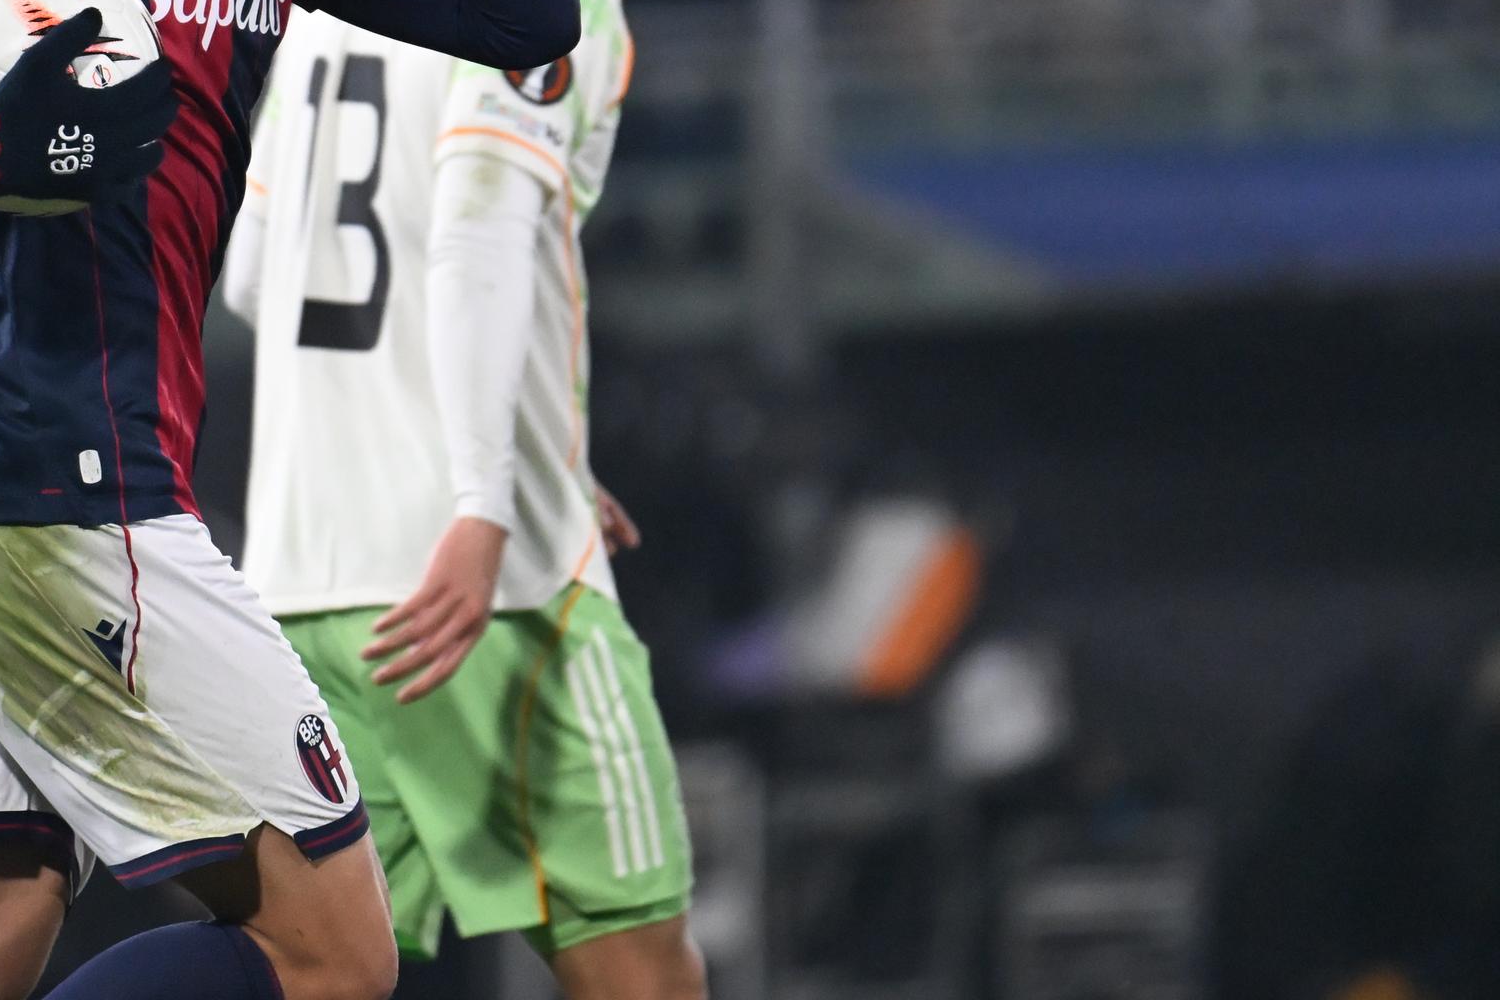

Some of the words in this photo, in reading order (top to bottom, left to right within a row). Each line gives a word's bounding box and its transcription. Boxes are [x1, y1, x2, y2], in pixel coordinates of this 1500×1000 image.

[48, 124, 81, 174] BFC
[80, 133, 95, 170] 1909
[296, 54, 391, 353] 13
[299, 716, 321, 742] BFC
